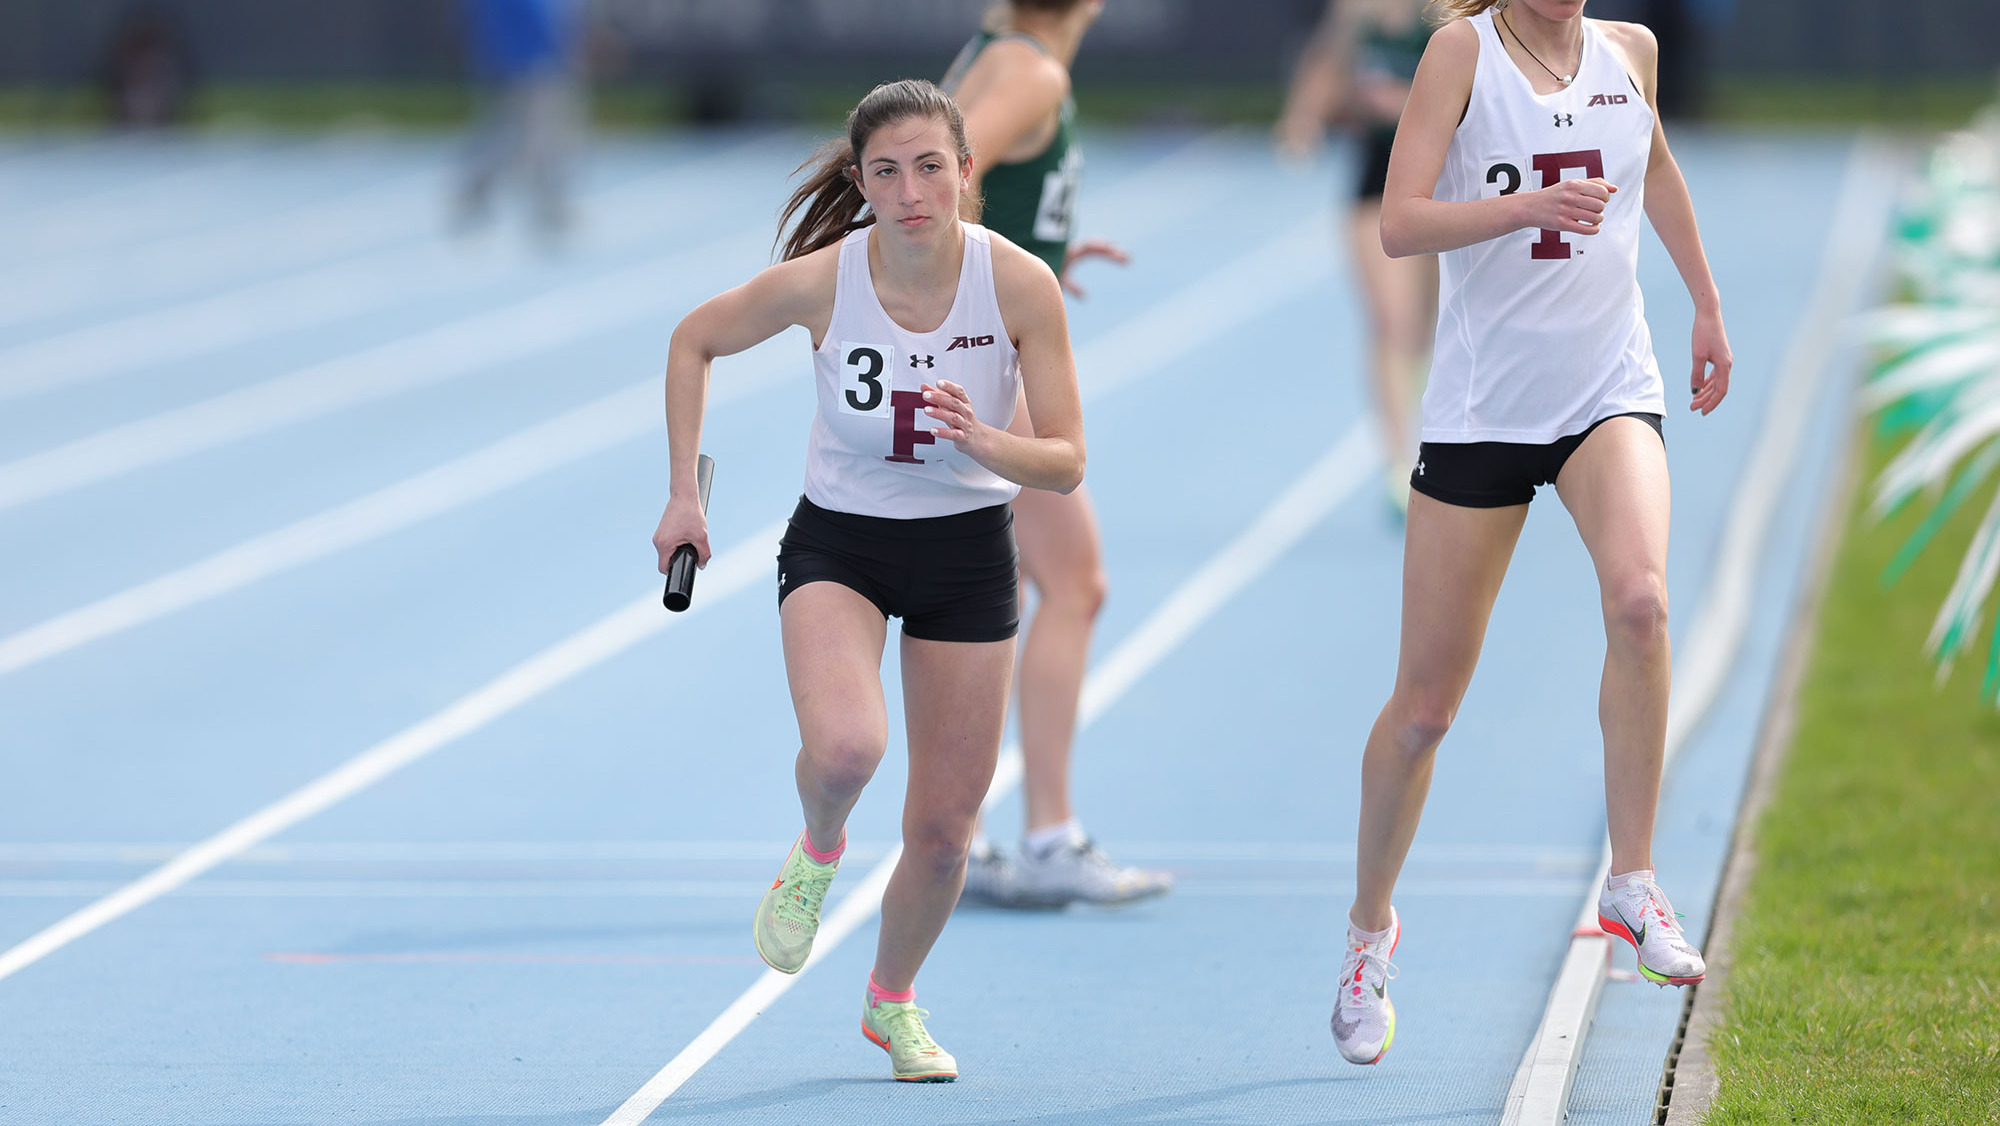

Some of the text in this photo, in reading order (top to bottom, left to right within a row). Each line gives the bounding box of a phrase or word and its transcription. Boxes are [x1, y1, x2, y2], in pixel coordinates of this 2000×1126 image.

[1587, 94, 1628, 108] A10
[946, 334, 995, 352] A10
[844, 347, 884, 412] 3
[884, 390, 940, 465] F
